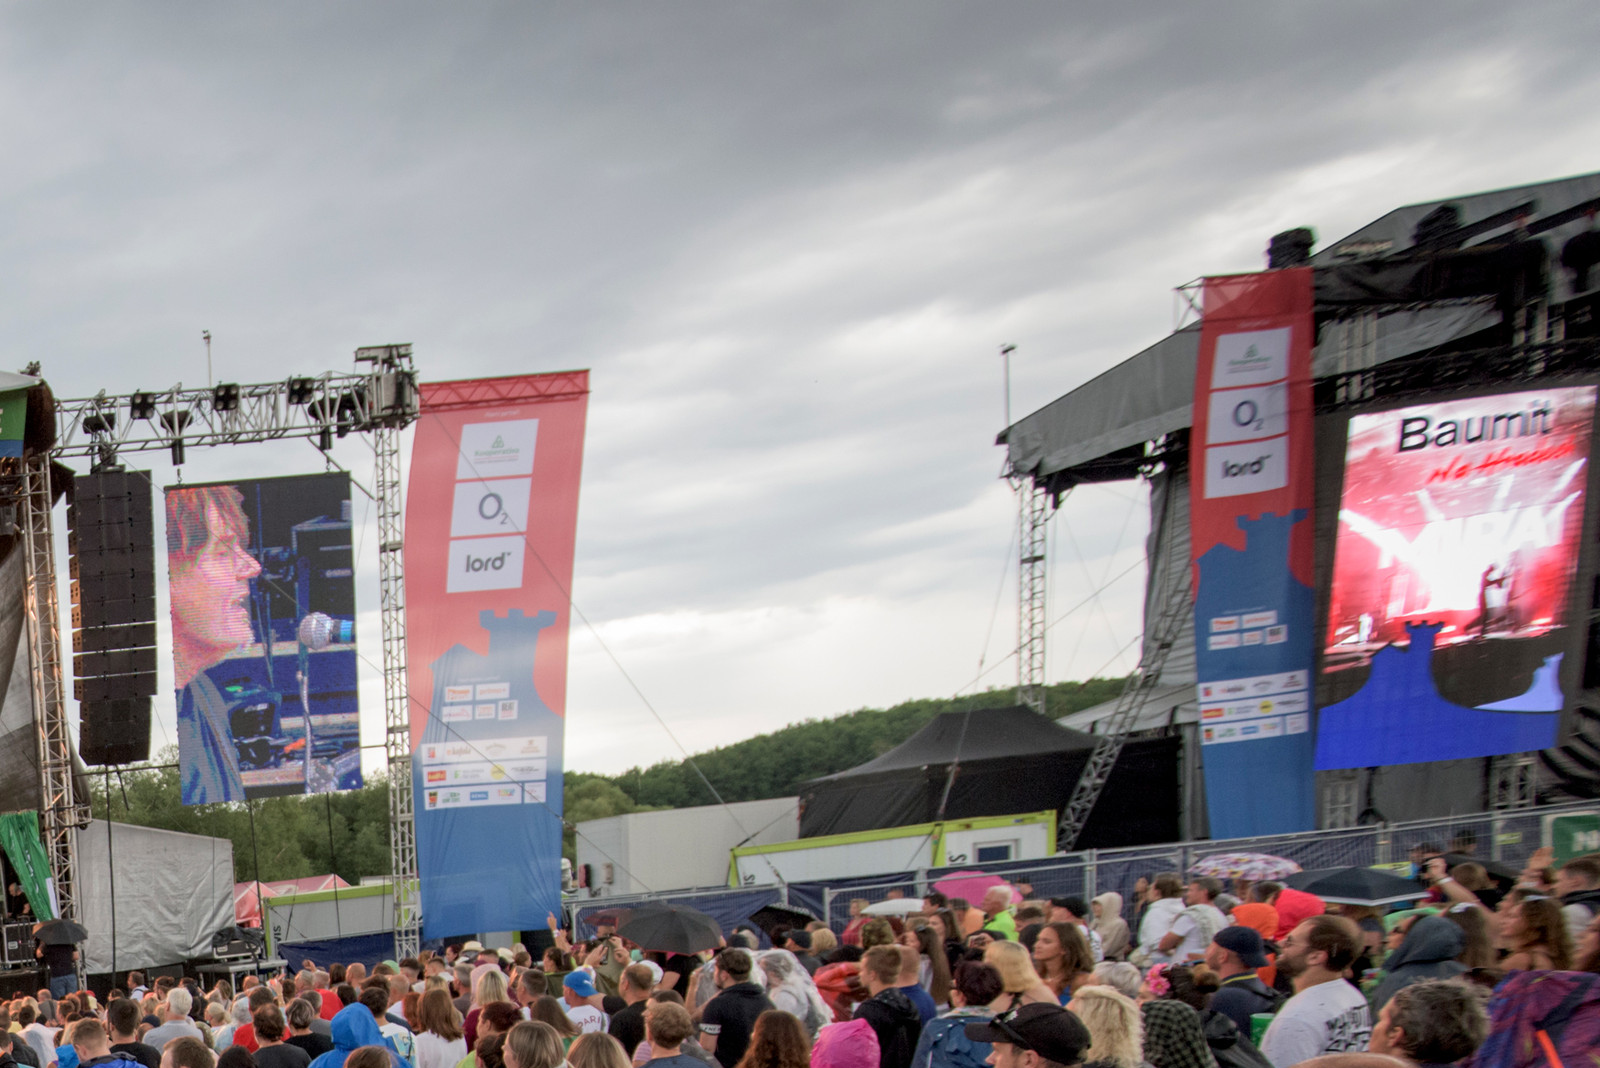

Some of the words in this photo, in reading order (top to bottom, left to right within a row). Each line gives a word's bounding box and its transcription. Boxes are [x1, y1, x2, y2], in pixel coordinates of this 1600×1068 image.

[1398, 399, 1554, 453] Baumit
[478, 492, 509, 525] O2
[465, 552, 506, 573] lord
